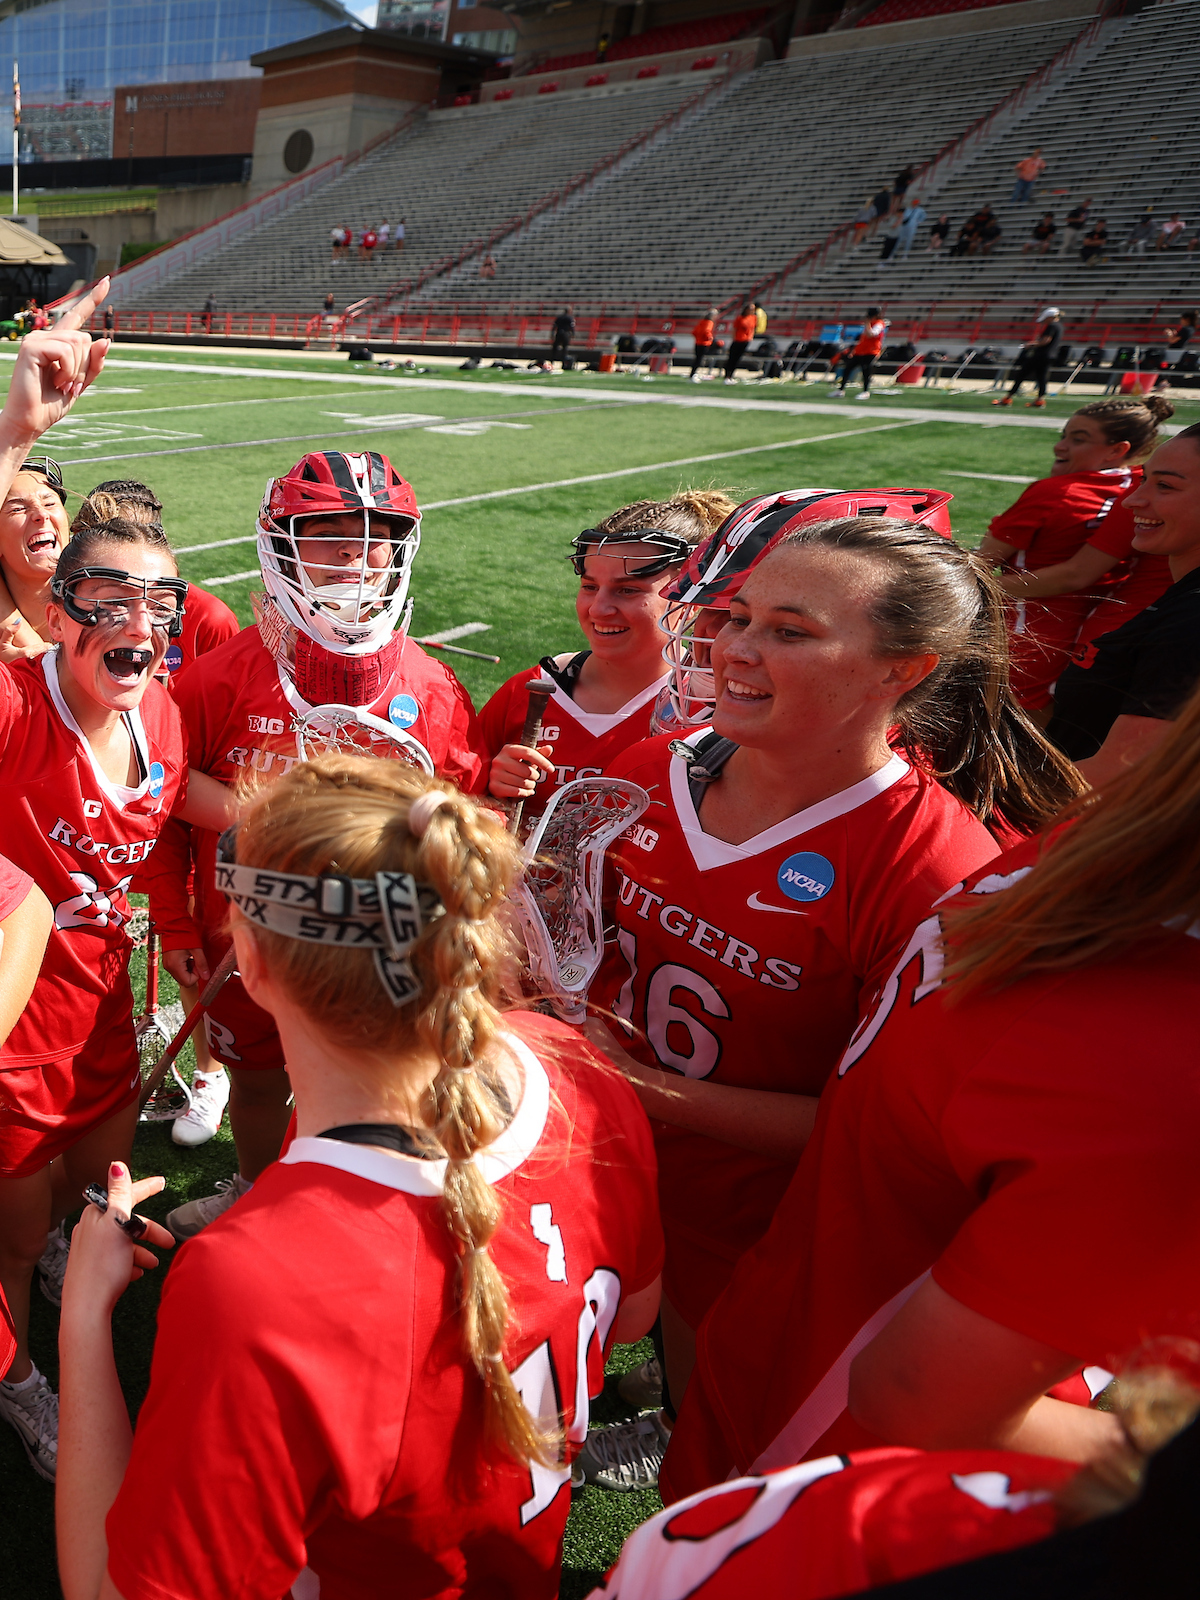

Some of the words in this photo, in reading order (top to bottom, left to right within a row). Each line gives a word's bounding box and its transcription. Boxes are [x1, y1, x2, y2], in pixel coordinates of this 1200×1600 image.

[391, 705, 417, 724] NCAA
[253, 873, 318, 903] STX
[781, 867, 827, 898] NCAA
[298, 915, 384, 945] STX
[616, 866, 803, 992] UTGERS
[613, 924, 734, 1081] 16
[202, 1010, 242, 1062] R
